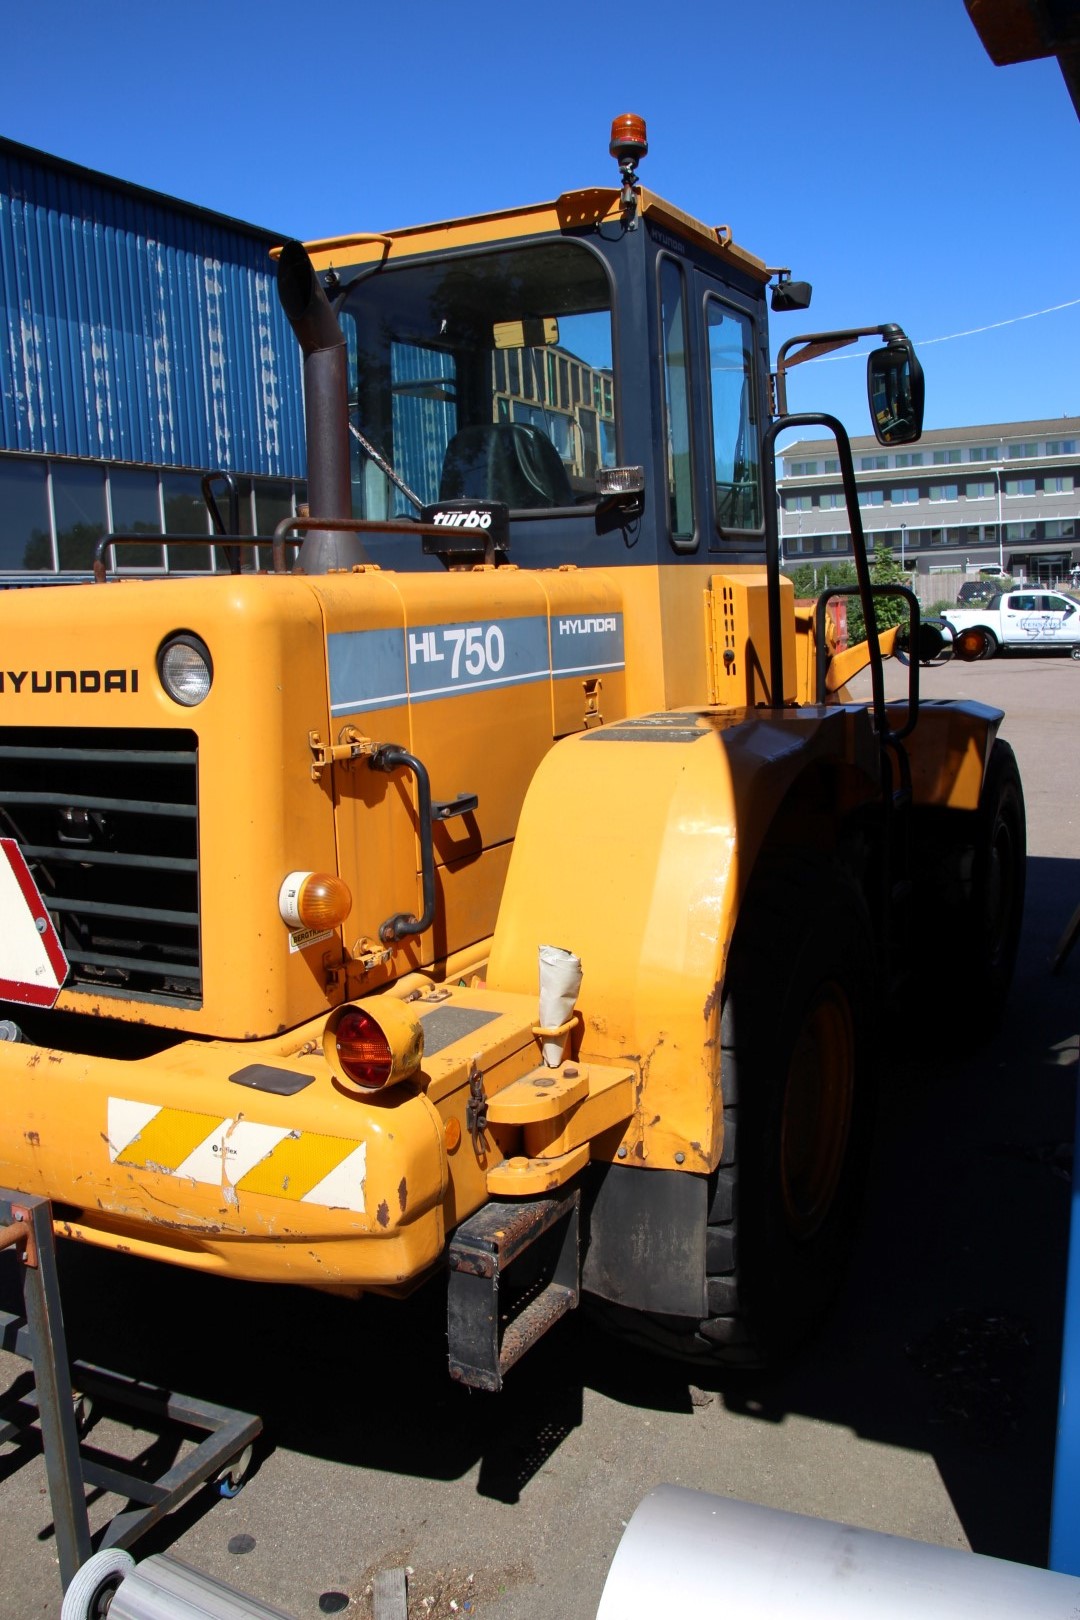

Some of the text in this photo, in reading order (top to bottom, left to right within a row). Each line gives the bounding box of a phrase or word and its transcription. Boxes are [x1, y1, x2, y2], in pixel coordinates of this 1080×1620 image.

[651, 228, 685, 253] HYUNDAI
[433, 510, 492, 529] turbo
[559, 618, 616, 635] HYUNDAI
[0, 669, 139, 693] YUNDAI
